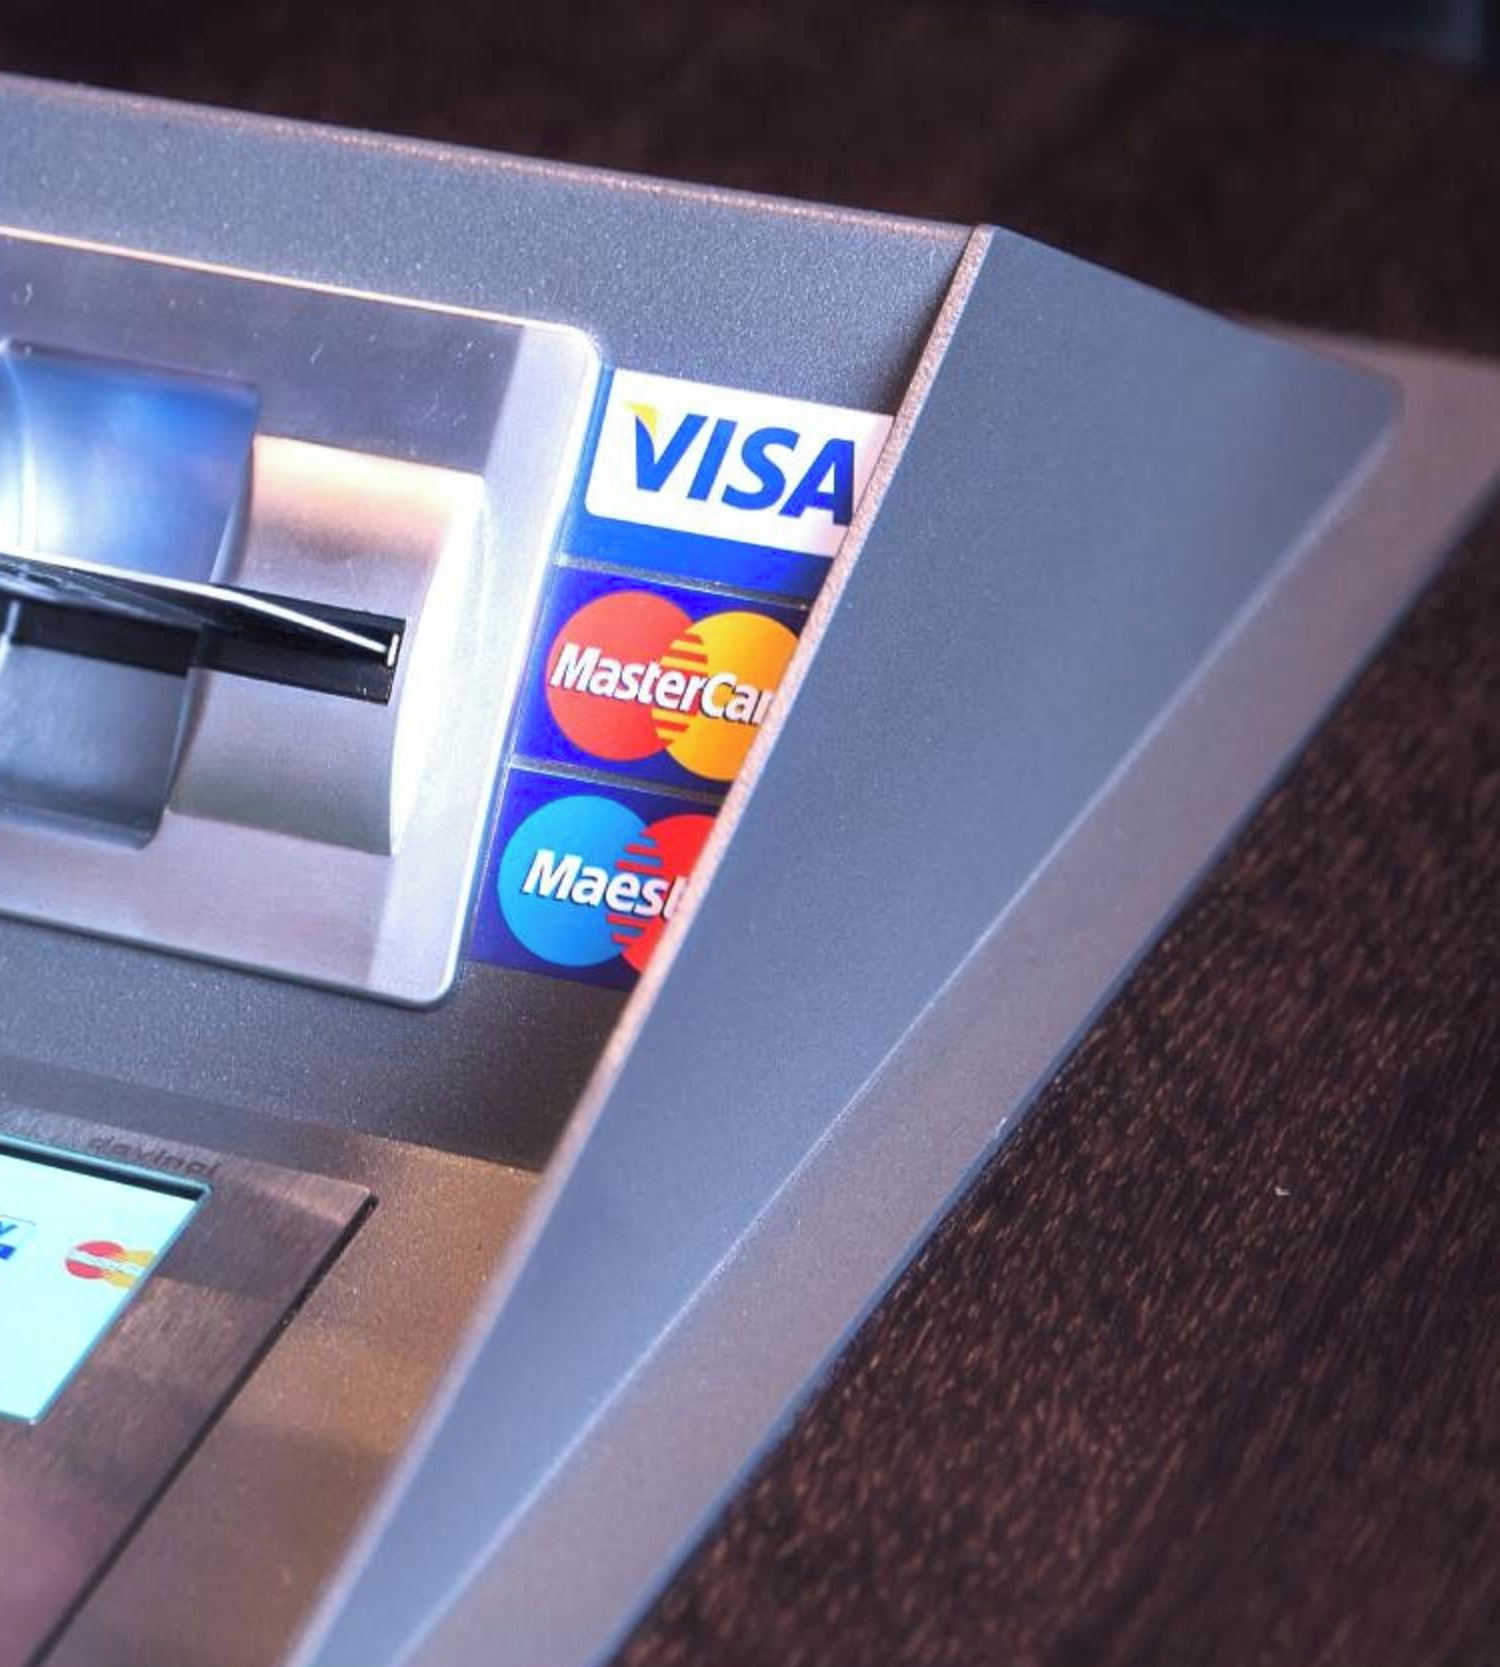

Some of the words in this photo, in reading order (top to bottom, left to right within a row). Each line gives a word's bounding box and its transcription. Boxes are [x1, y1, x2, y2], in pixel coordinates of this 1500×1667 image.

[630, 413, 855, 526] VISA
[549, 641, 776, 727] MasterCar
[521, 848, 690, 921] Maest
